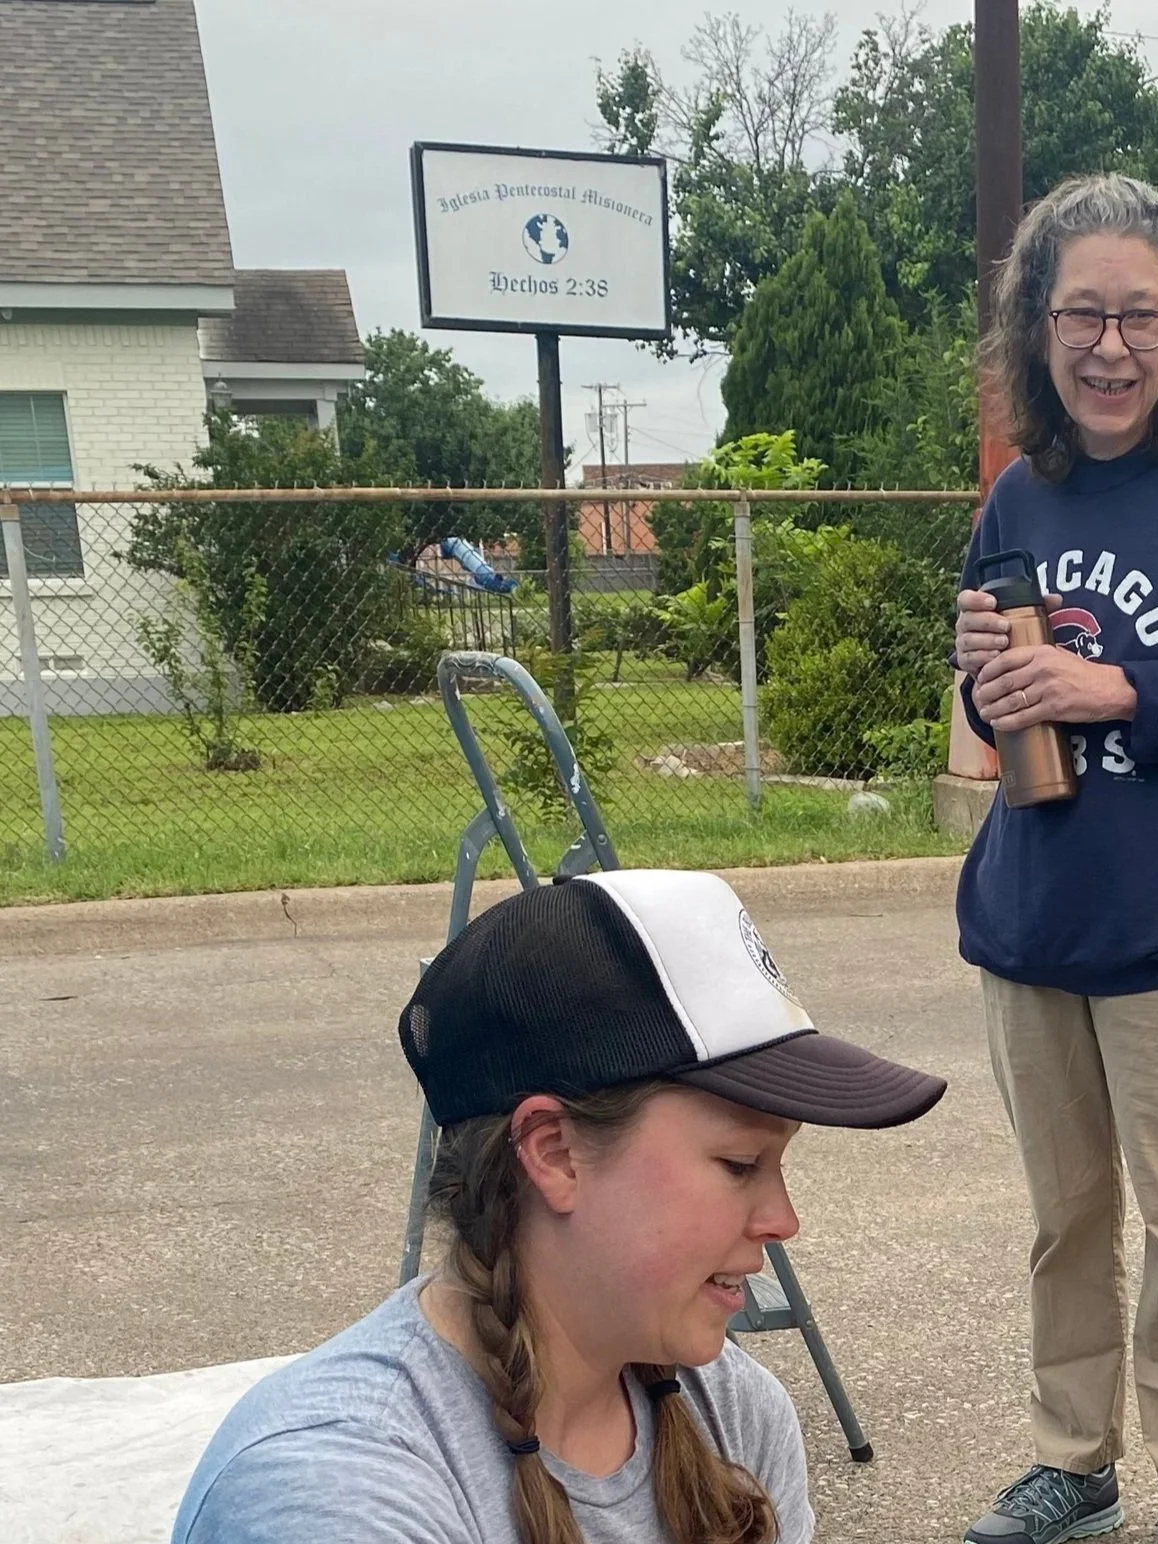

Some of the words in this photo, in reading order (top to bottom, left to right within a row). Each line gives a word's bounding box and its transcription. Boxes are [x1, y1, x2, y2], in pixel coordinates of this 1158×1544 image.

[437, 188, 491, 213] Iglesia
[494, 183, 577, 201] Pentecostal
[580, 189, 653, 226] Misionera
[489, 271, 559, 297] Hechos
[565, 278, 609, 298] 2:38
